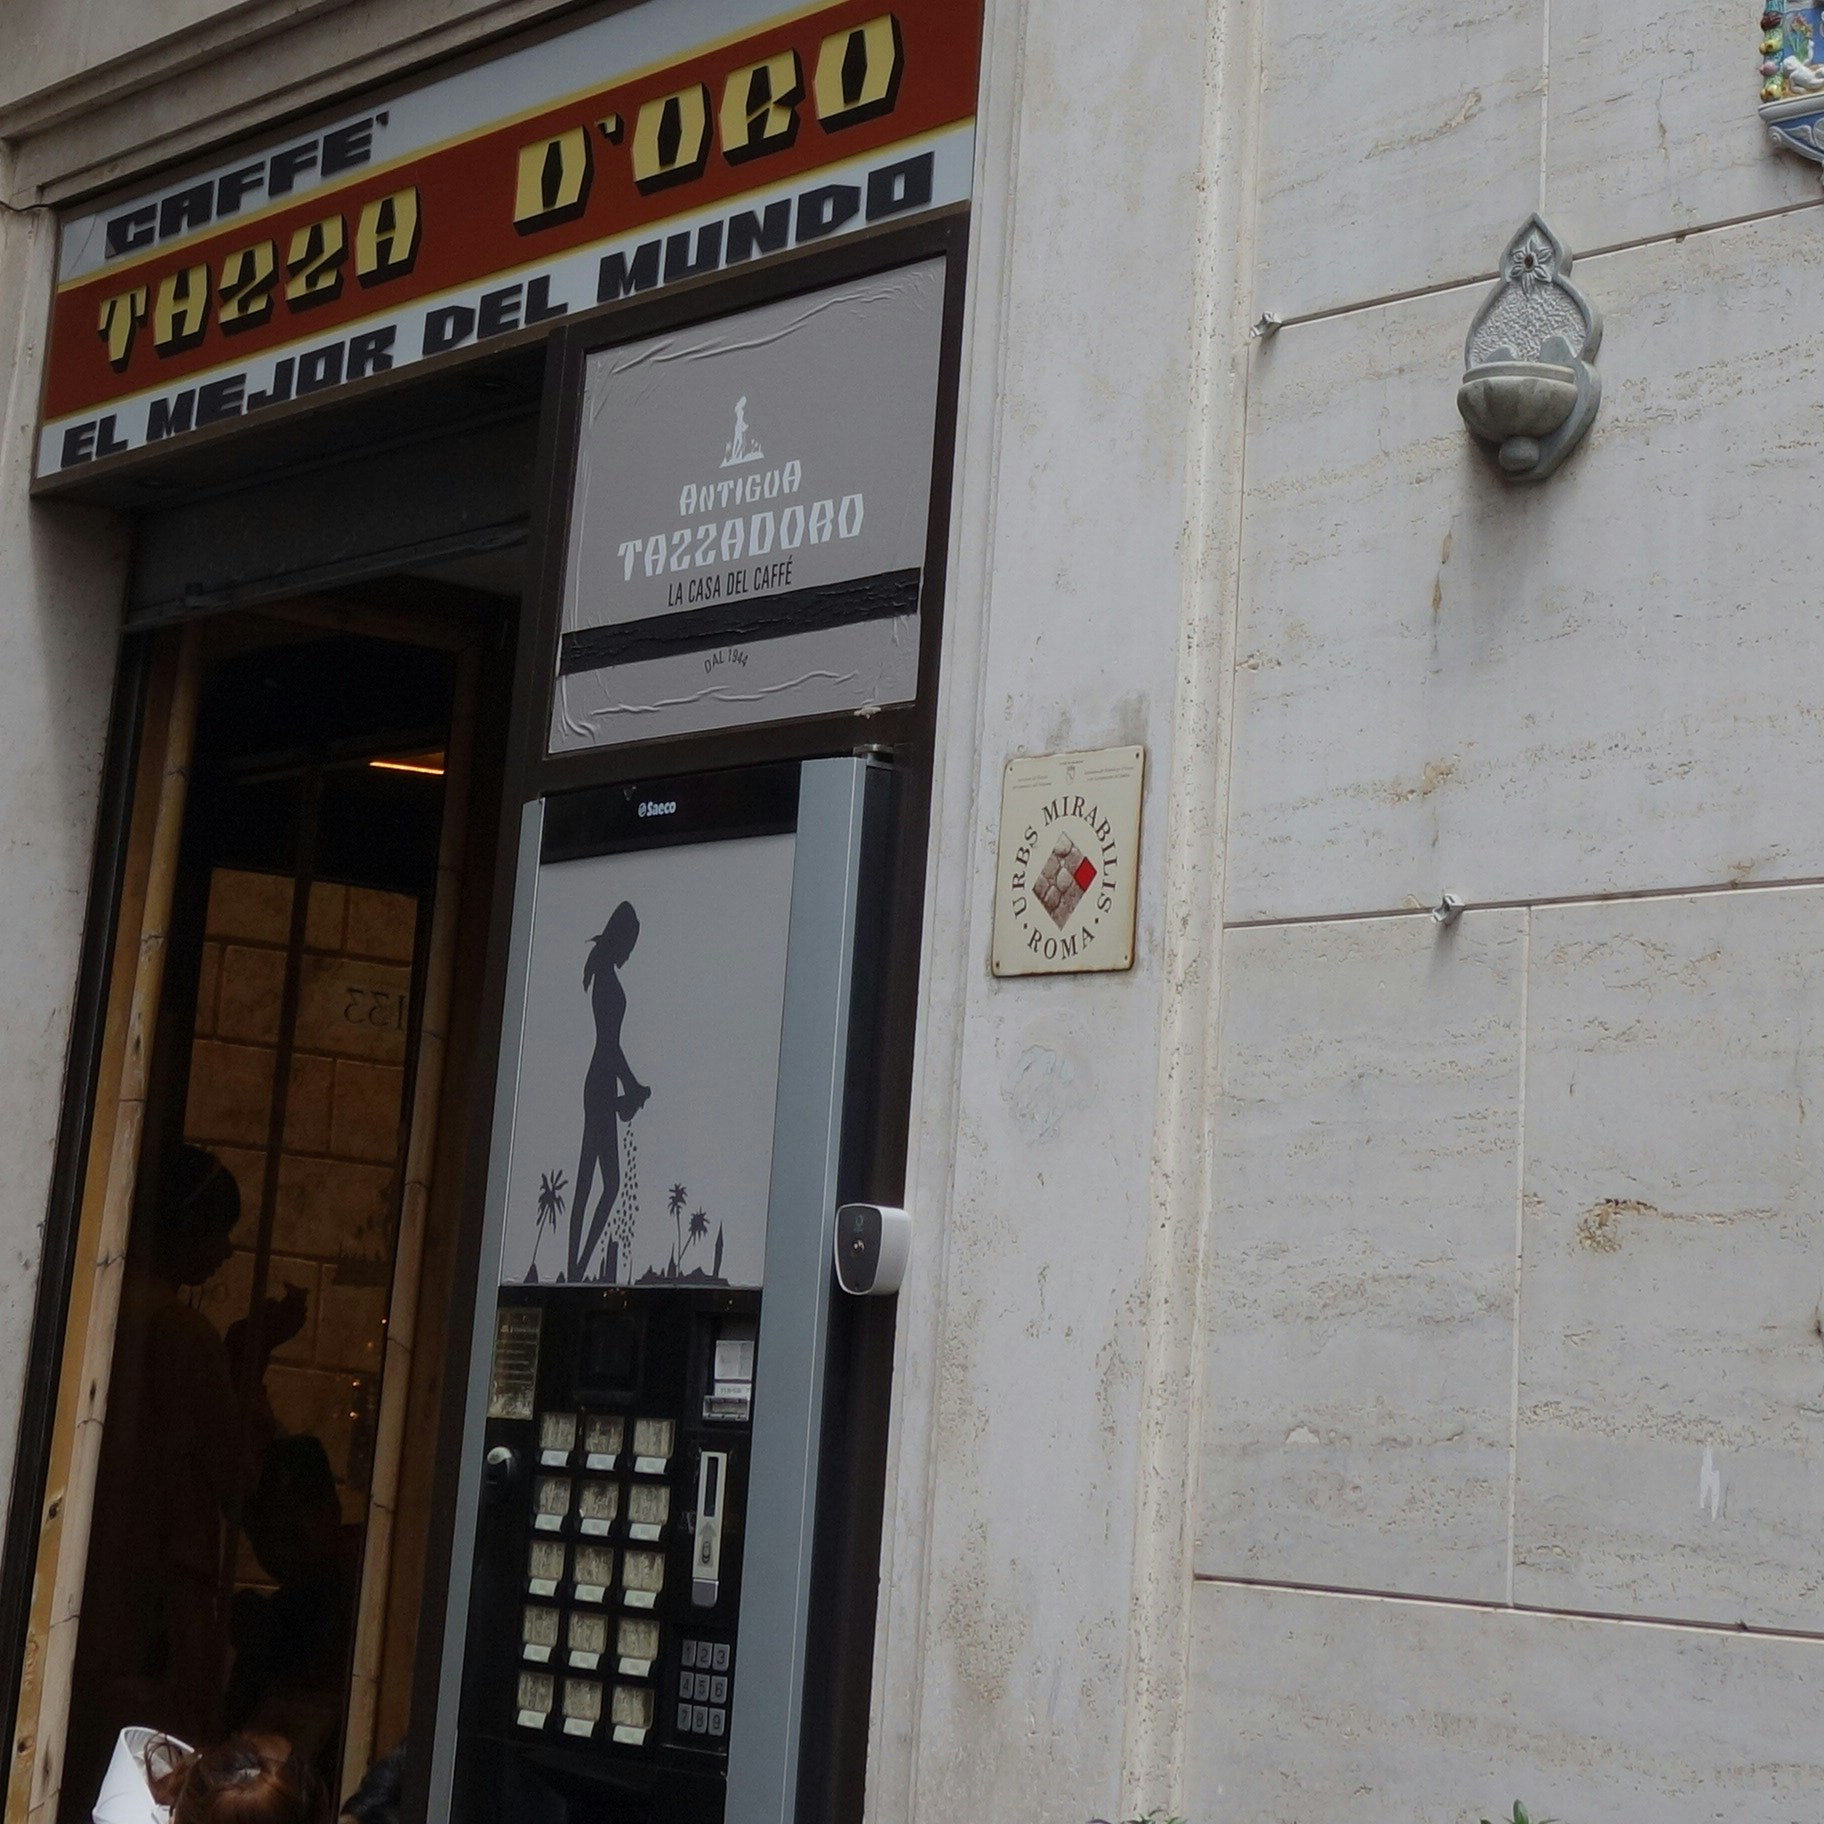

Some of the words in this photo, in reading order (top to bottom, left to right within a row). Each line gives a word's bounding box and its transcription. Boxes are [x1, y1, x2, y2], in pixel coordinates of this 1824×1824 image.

[98, 185, 424, 373] TAZZA
[512, 12, 906, 236] D'ORO
[59, 412, 129, 470] EL
[144, 324, 398, 441] MEJOR
[421, 274, 571, 358] DEL
[595, 151, 936, 304] MUNDO
[617, 493, 864, 581] TAZZADORO
[667, 581, 683, 607] LA
[688, 575, 721, 602] CASA
[727, 569, 748, 595] DEL
[753, 554, 793, 591] CAFFÉ
[704, 652, 724, 674] DAL
[728, 649, 749, 667] 1944
[647, 801, 676, 816] Saeco
[1011, 825, 1039, 919] URBS
[1041, 795, 1119, 914] MIRABILIS
[1027, 925, 1095, 961] ROMA
